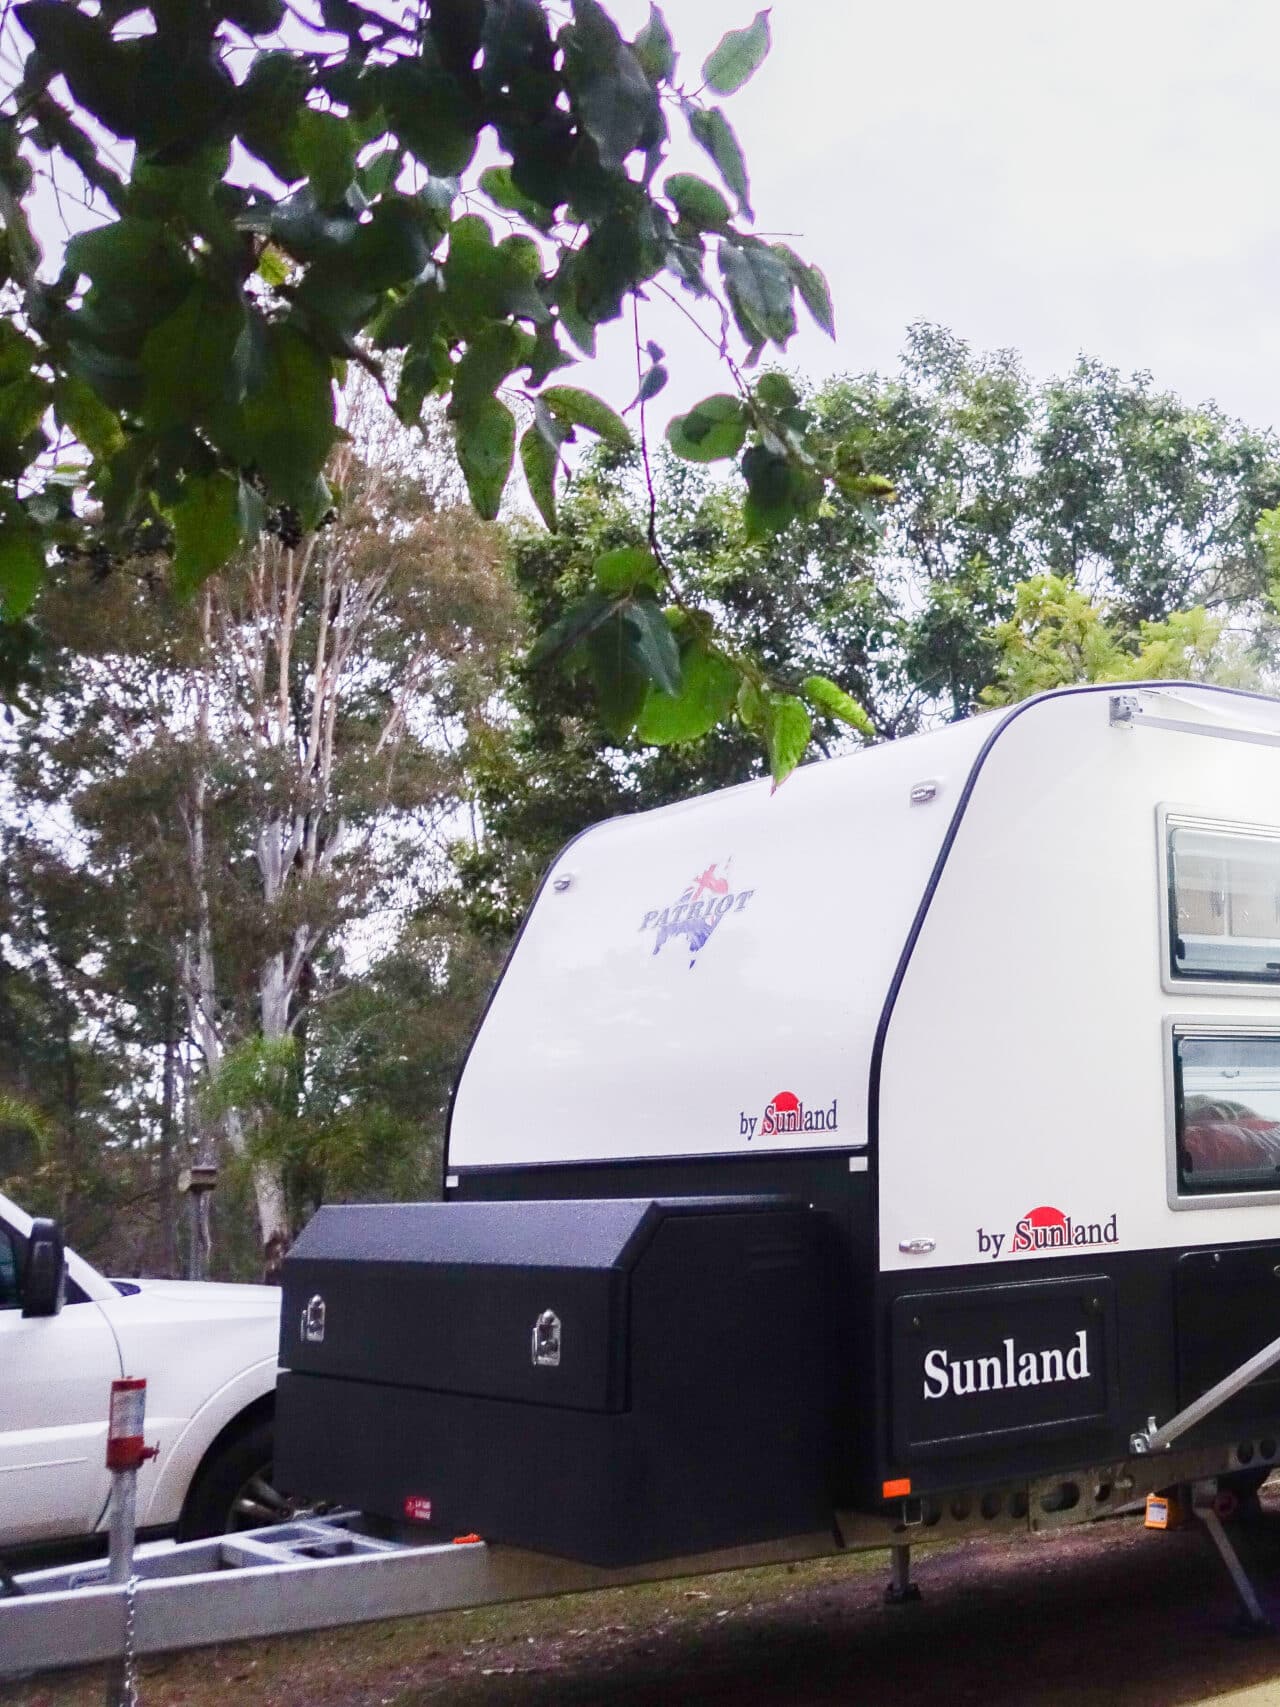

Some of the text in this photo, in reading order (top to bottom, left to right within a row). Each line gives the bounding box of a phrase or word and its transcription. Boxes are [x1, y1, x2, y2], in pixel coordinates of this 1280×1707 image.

[638, 889, 755, 931] PATRIOT
[740, 1098, 838, 1140] by Sunland
[977, 1213, 1119, 1258] by Sunland
[924, 1330, 1091, 1400] Sunland
